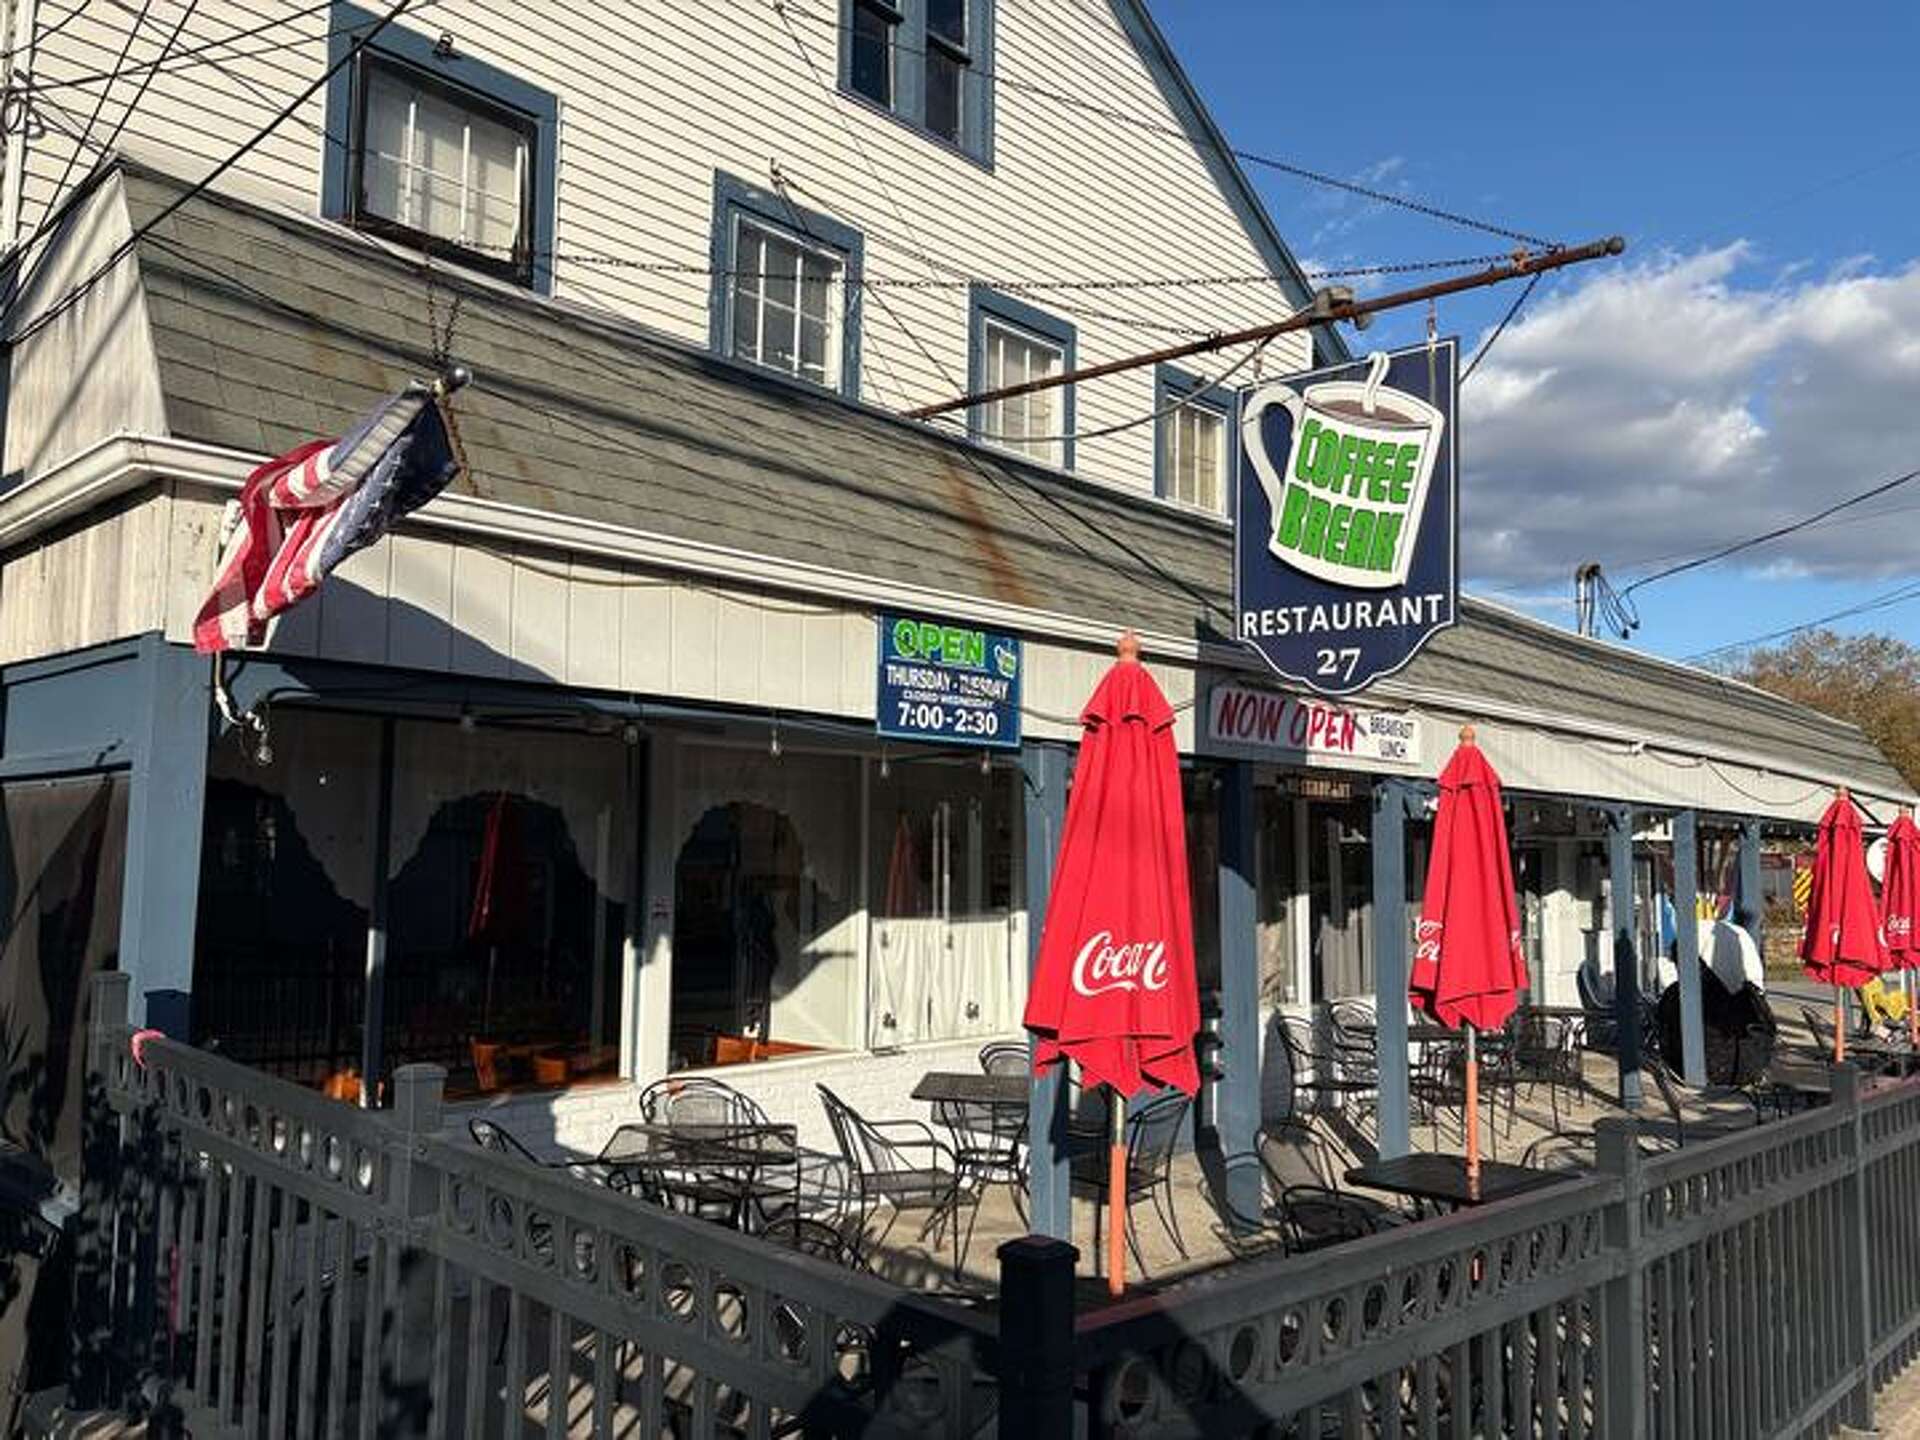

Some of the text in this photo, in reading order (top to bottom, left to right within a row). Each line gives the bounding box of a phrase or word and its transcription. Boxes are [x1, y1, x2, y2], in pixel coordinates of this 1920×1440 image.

[1295, 418, 1420, 504] COFFEE
[1276, 482, 1405, 573] BREAK
[1242, 594, 1444, 638] RESTAURANT
[893, 618, 985, 667] OPEN
[1315, 648, 1362, 681] 27
[886, 664, 950, 691] THURSDAY
[1218, 690, 1357, 751] NOW OPEN
